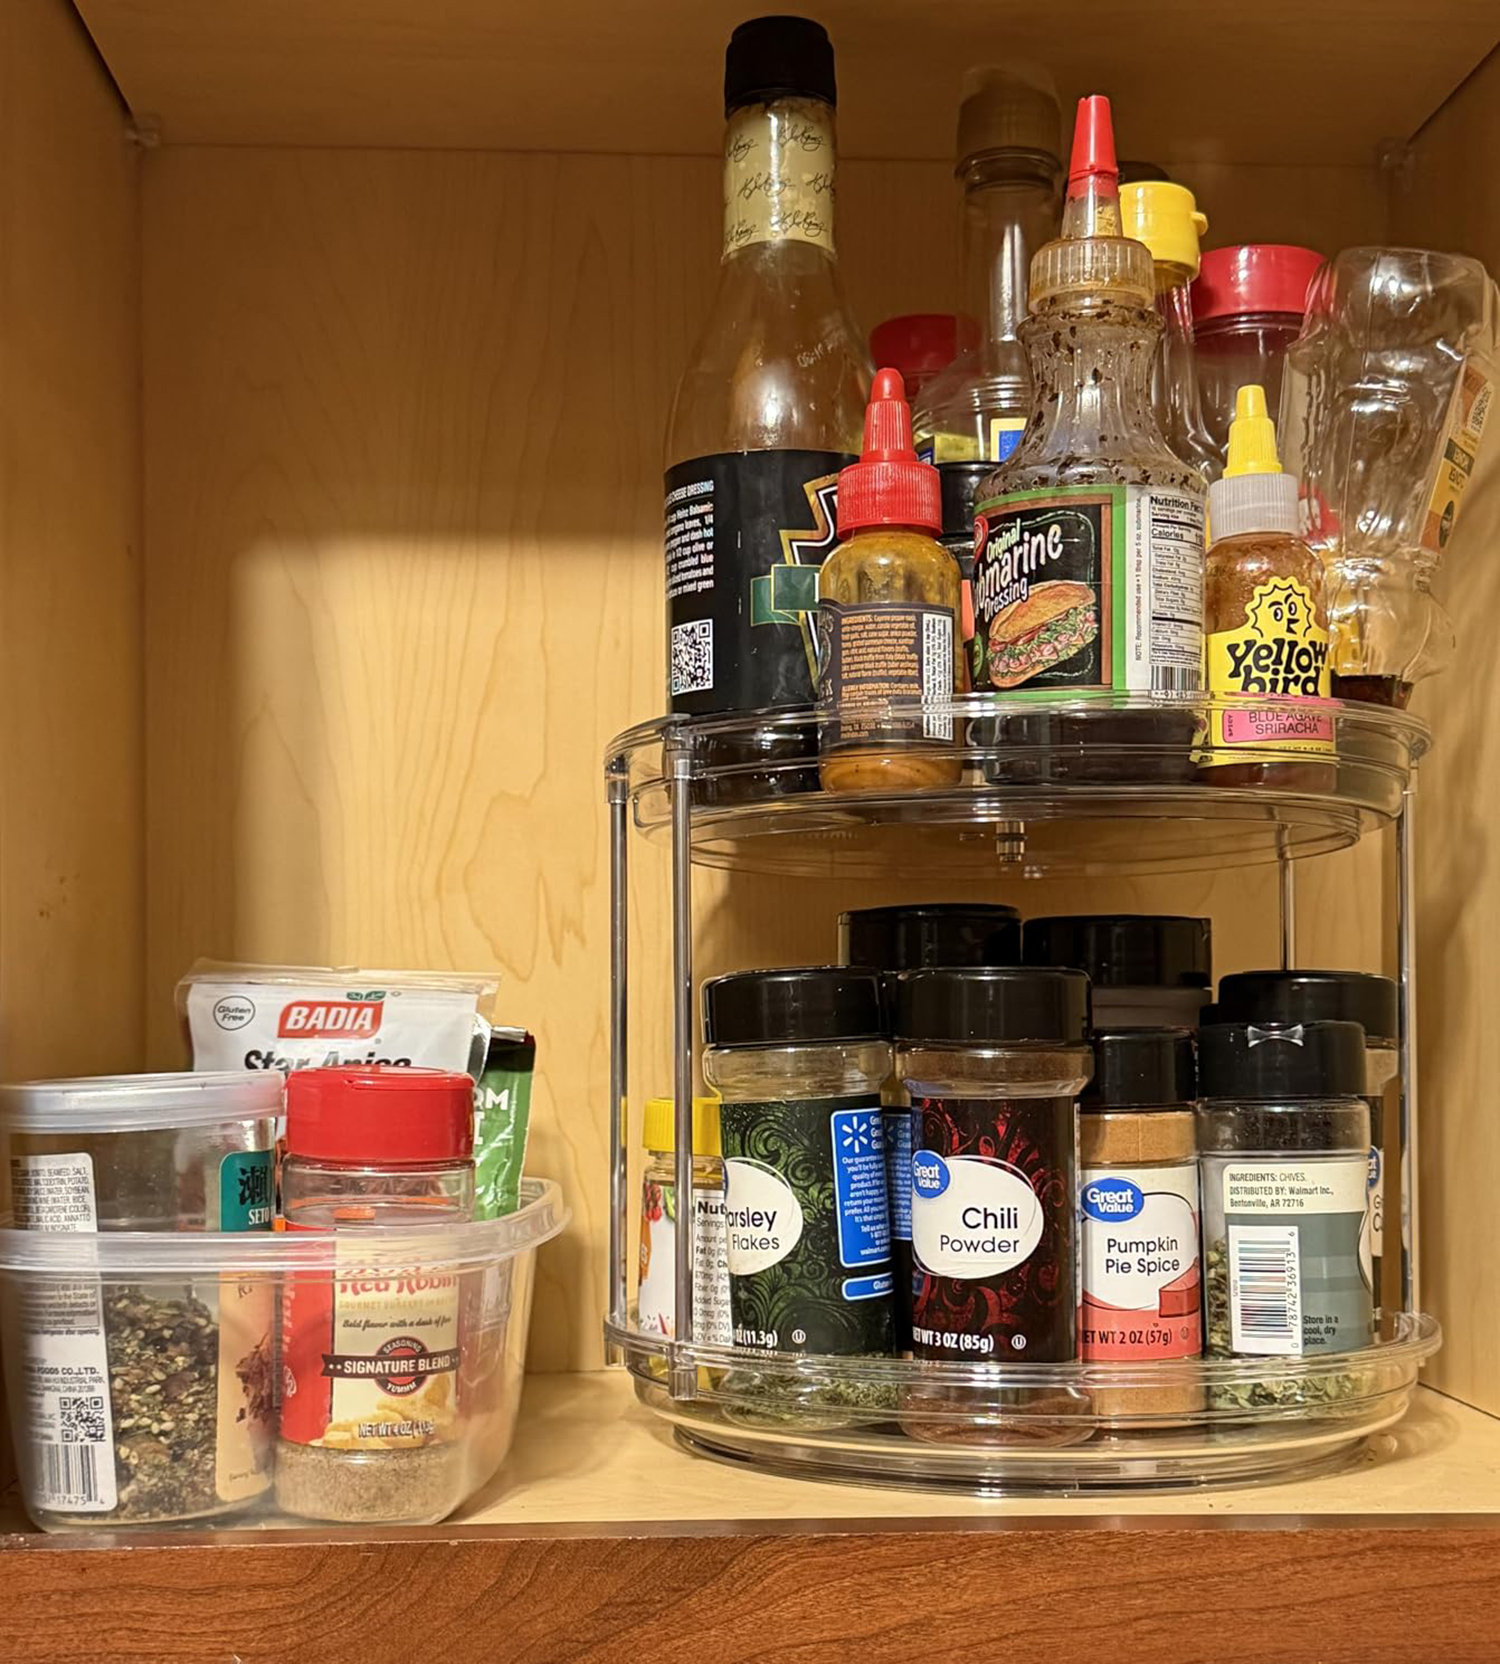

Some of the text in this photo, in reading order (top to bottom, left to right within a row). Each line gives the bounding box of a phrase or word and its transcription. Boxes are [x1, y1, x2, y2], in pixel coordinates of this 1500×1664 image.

[1150, 495, 1189, 509] Nutrition
[703, 527, 714, 537] hot
[1151, 528, 1184, 539] Calories
[706, 541, 714, 550] or
[987, 518, 1021, 563] Original
[701, 554, 714, 564] blue
[1135, 548, 1143, 558] per
[702, 565, 714, 575] and
[975, 524, 1063, 617] bmarine
[697, 580, 714, 592] green
[1226, 637, 1330, 679] Yellow
[1241, 664, 1321, 697] bird
[1248, 710, 1284, 724] BLUE
[1255, 722, 1319, 735] SRIRACHA
[217, 1005, 251, 1014] Gluten
[222, 1013, 245, 1022] Free
[285, 1006, 373, 1031] BADIA
[913, 1160, 940, 1179] Great
[1229, 1172, 1278, 1182] INGREDIENTS:
[1086, 1187, 1134, 1204] Great
[1229, 1185, 1334, 1196] DISTRIBUTED BY: Walmart Inc.,
[1098, 1202, 1134, 1214] Value
[1230, 1198, 1304, 1208] Bentonville, AR 72716
[728, 1207, 777, 1232] arsley
[962, 1207, 1018, 1230] Chili
[732, 1233, 780, 1250] Flakes
[940, 1235, 1020, 1253] Powder
[1107, 1237, 1178, 1256] Pumpkin
[695, 1246, 706, 1255] Fat
[1105, 1258, 1180, 1276] Pie Spice
[1286, 1251, 1297, 1287] 36913
[1287, 1292, 1298, 1327] 78742
[1303, 1315, 1324, 1324] Store
[1325, 1315, 1333, 1324] in
[1084, 1328, 1173, 1346] ET WT 2 OZ (57g)
[1303, 1325, 1336, 1336] cool, dry
[382, 1339, 423, 1354] SEASONING
[743, 1329, 779, 1349] (11.3g)
[921, 1329, 934, 1346] WT
[934, 1331, 941, 1347] 3
[942, 1332, 958, 1348] OZ
[959, 1333, 994, 1354] (85g)
[1303, 1336, 1327, 1347] place.
[344, 1355, 451, 1374] SIGNATURE BLEND
[358, 1423, 376, 1438] NET
[400, 1420, 413, 1435] OZ
